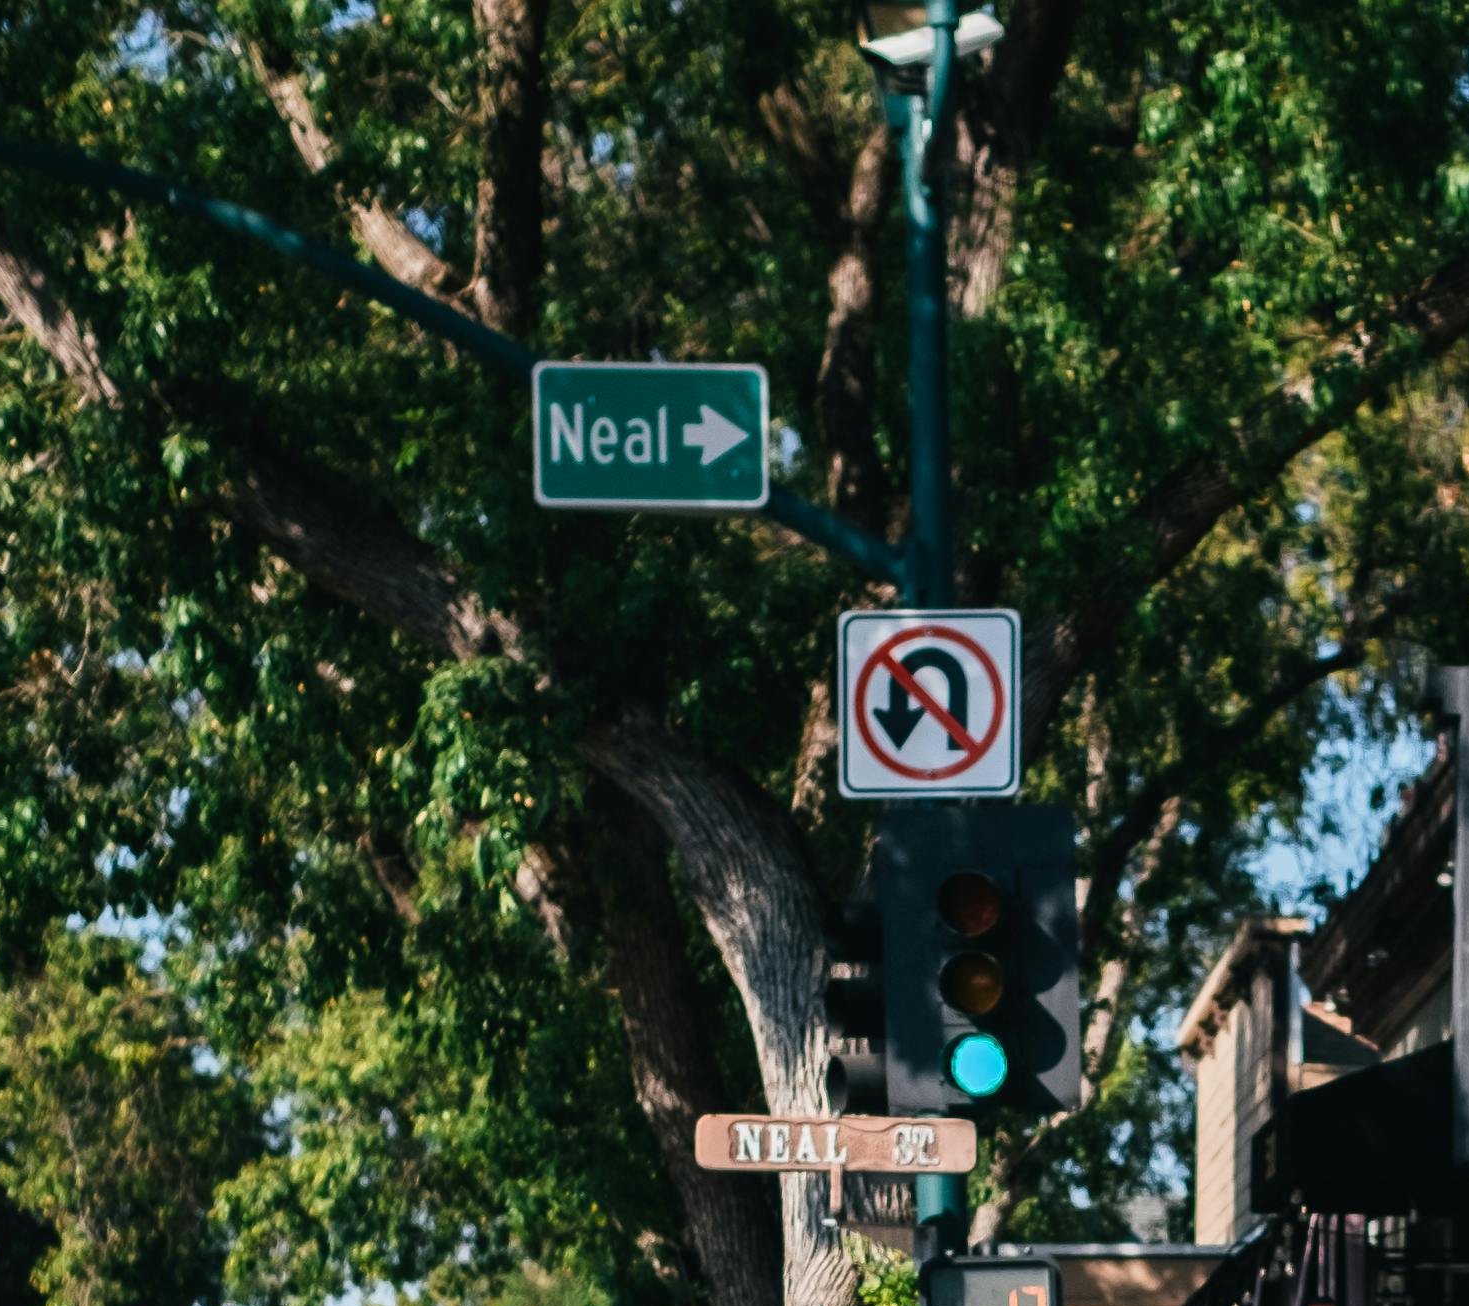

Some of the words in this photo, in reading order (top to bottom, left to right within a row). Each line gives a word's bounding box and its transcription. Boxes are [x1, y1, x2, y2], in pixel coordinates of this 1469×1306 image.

[548, 402, 669, 465] Neal
[735, 1122, 849, 1165] NEAL
[892, 1123, 941, 1167] ST
